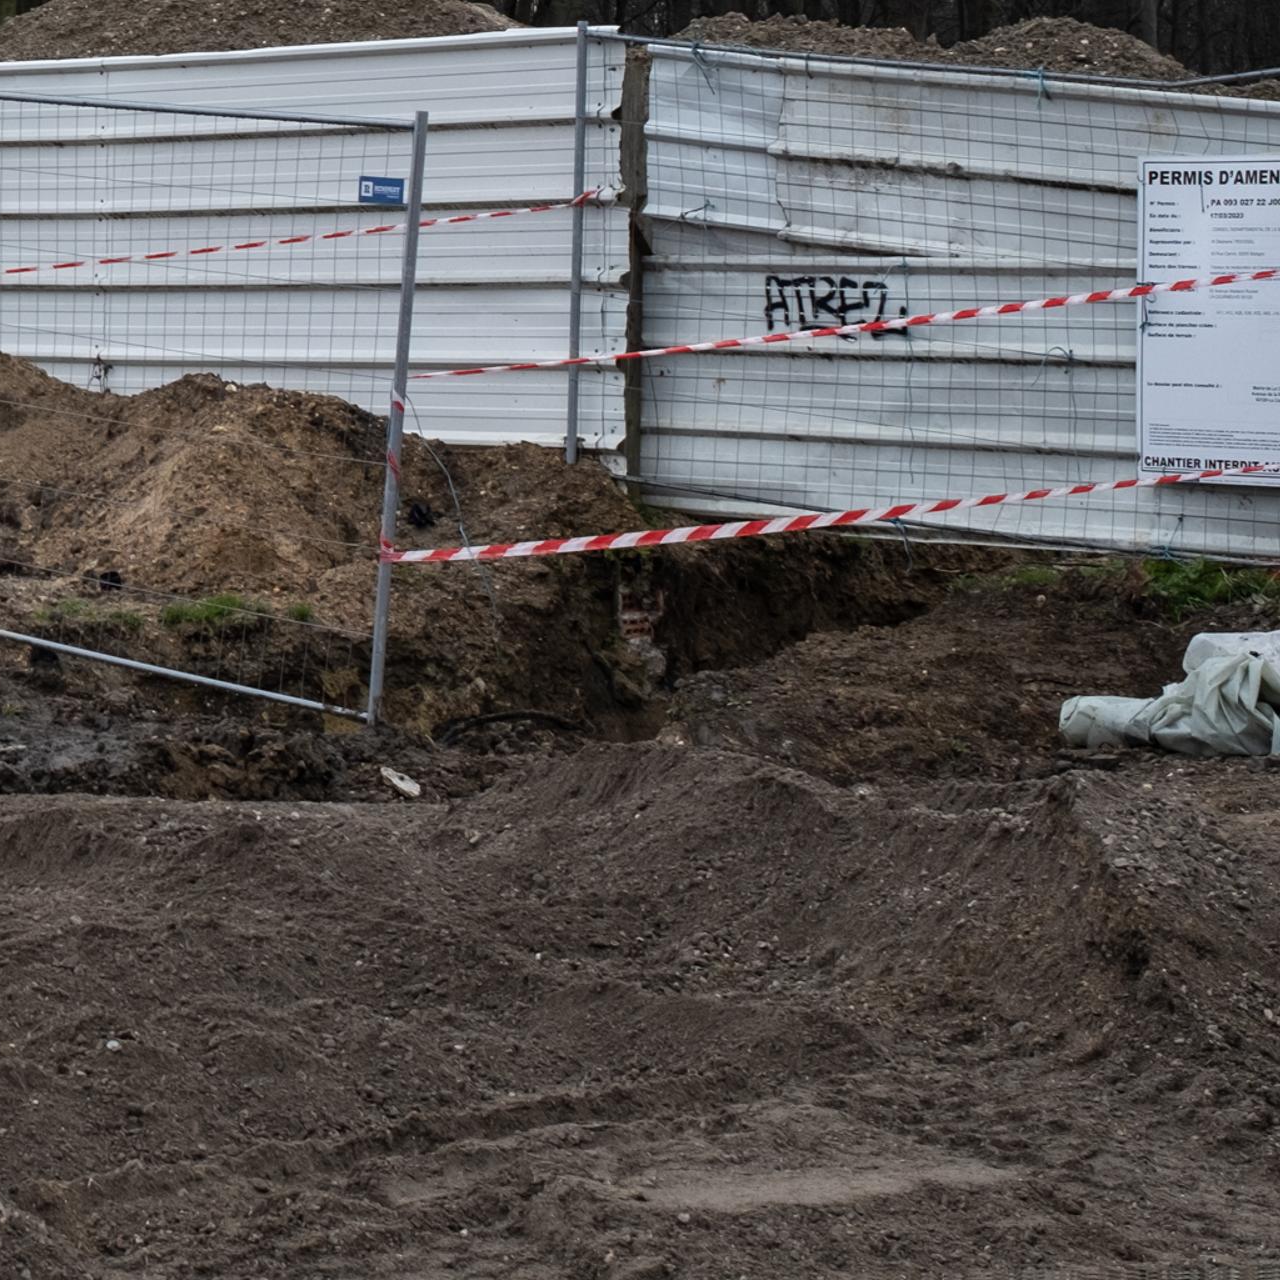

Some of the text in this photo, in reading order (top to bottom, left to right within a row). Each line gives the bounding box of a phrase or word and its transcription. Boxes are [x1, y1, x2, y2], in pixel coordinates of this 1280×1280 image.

[1149, 170, 1213, 185] PERMIS
[1144, 456, 1201, 469] CHANTIER
[1205, 459, 1260, 470] INTERDIT
